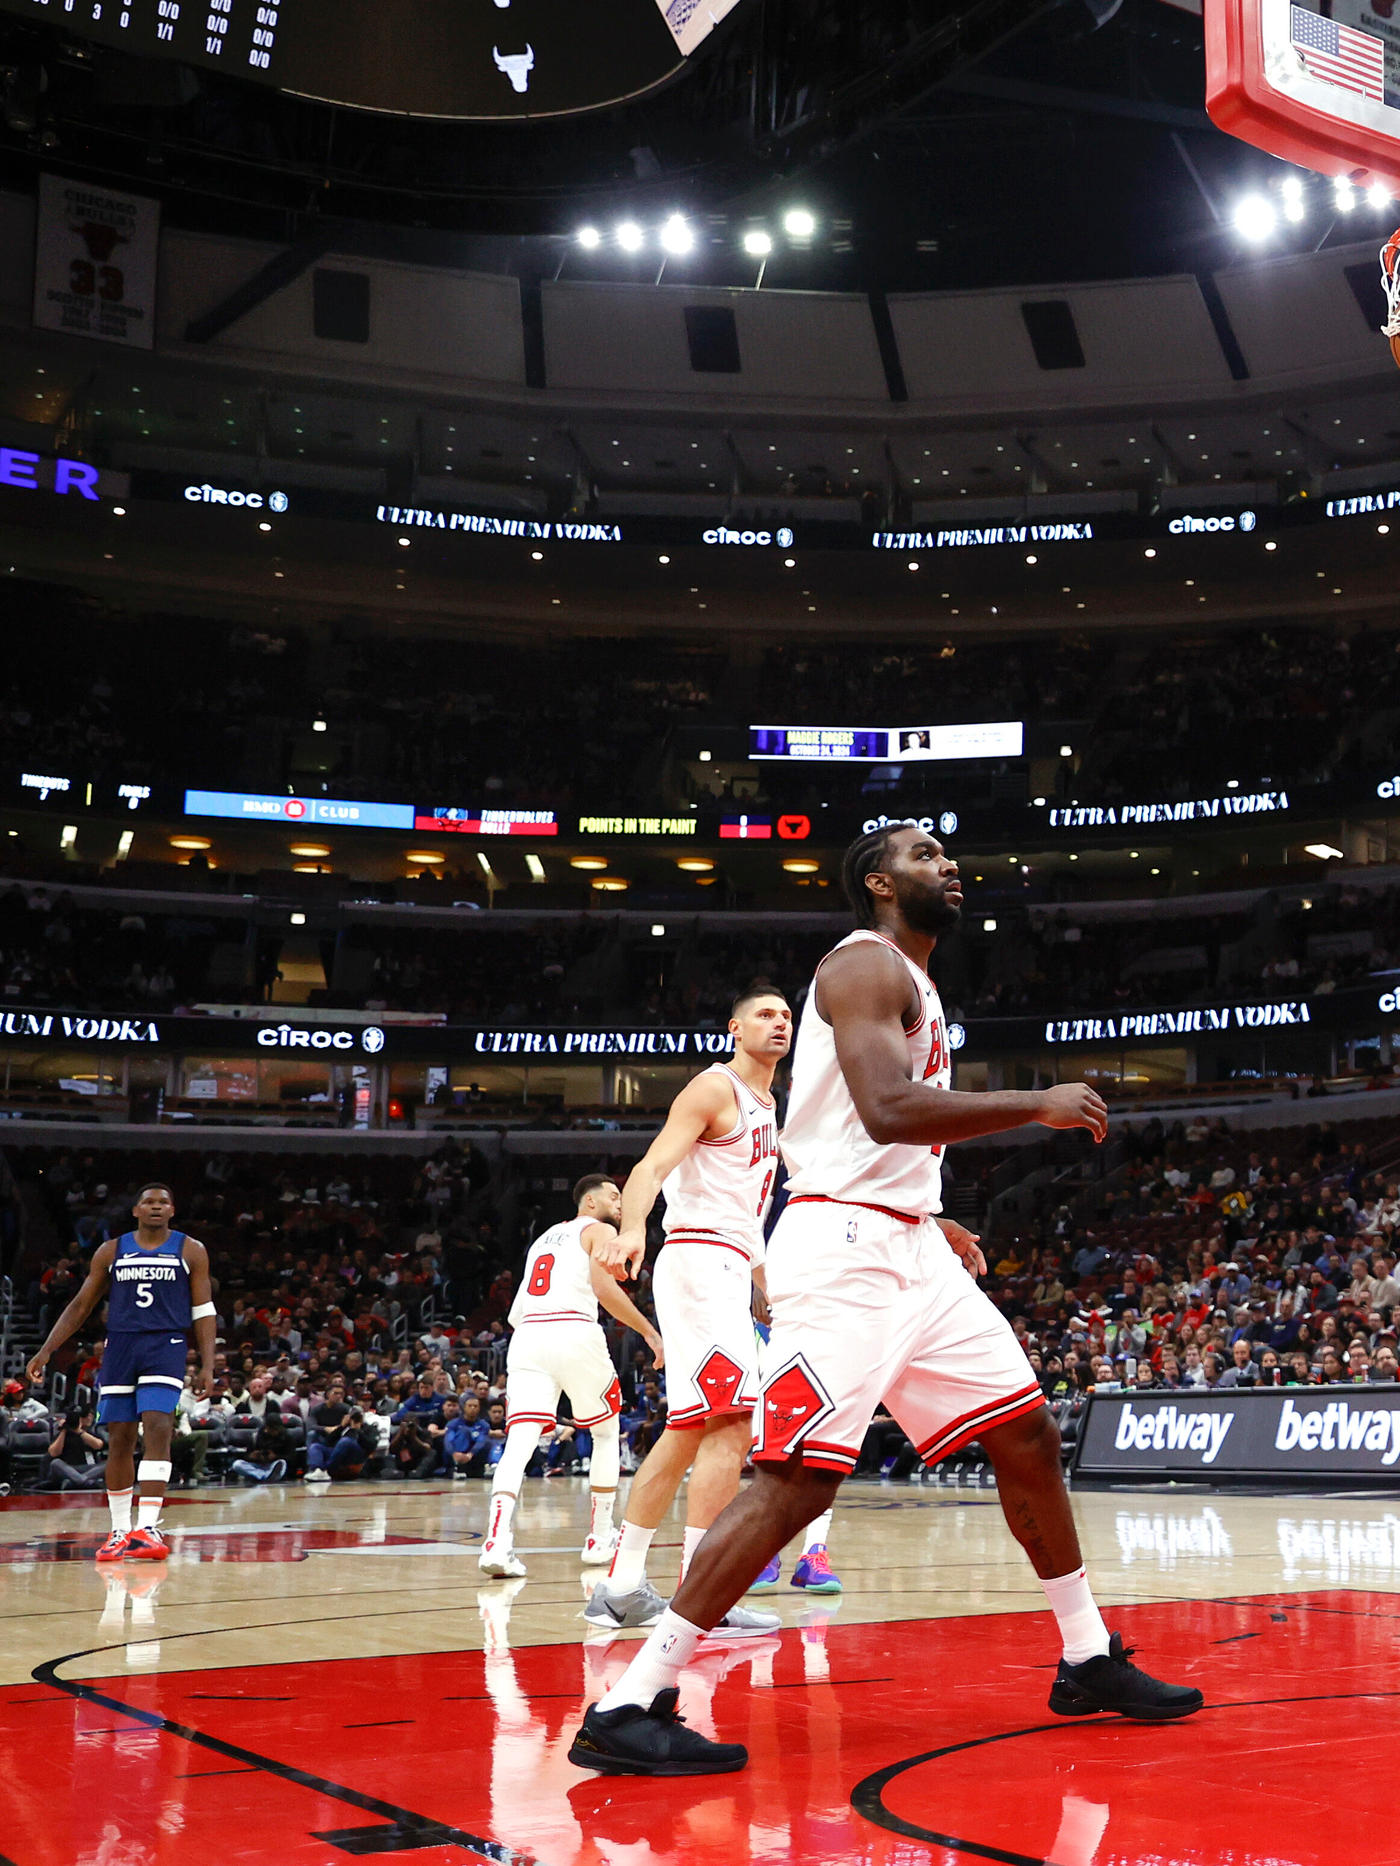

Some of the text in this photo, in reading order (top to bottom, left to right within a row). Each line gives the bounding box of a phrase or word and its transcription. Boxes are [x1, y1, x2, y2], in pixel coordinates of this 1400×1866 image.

[157, 0, 274, 48] 0/0 0/0 0/0
[256, 7, 278, 27] 0/0
[92, 4, 102, 20] 3
[119, 12, 130, 28] 0
[157, 22, 174, 41] 1/1
[205, 36, 222, 55] 1/1
[248, 49, 270, 69] 0/0
[70, 258, 124, 302] 33
[184, 483, 264, 508] CÎROC
[1326, 495, 1385, 518] ULTRA
[376, 505, 622, 542] ULTRA PREMIUM VODKA
[702, 526, 772, 546] CÎROC
[872, 521, 1093, 549] ULTRA PREMIUM VODKA
[1168, 514, 1235, 534] CÎROC
[319, 806, 360, 820] CLUB
[1049, 791, 1289, 827] ULTRA PREMIUM VODKA
[578, 816, 697, 835] POINTS IN THE PAINT
[61, 1016, 159, 1042] VODKA
[1045, 1002, 1311, 1043] ULTRA PREMIUM VODKA
[257, 1023, 354, 1049] CÎROC
[474, 1032, 559, 1053] ULTRA
[563, 1032, 687, 1053] PREMIUM
[757, 1169, 773, 1217] 9
[115, 1267, 177, 1282] MINNESOTA
[527, 1253, 556, 1297] 8
[135, 1283, 155, 1308] 5
[1114, 1402, 1235, 1464] betway
